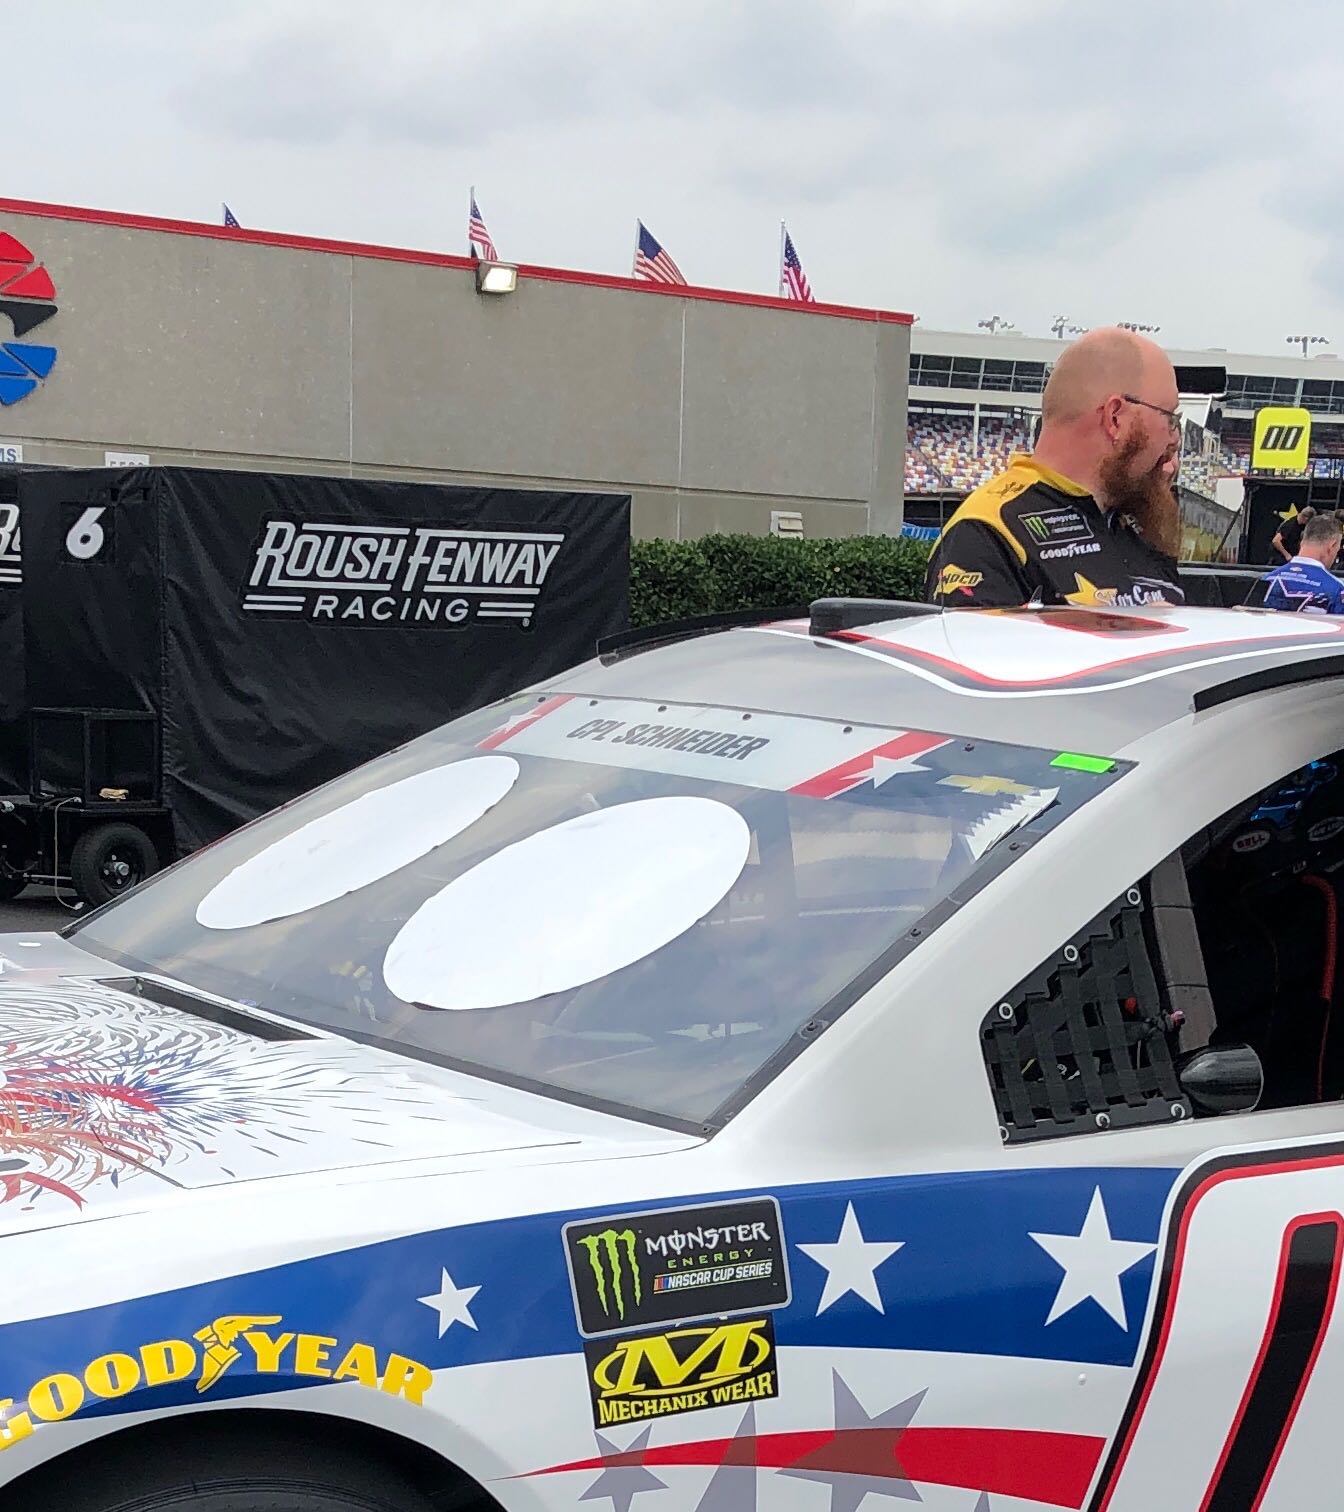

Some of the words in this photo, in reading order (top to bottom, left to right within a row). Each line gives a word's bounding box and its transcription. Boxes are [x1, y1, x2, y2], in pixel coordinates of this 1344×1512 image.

[1260, 425, 1304, 450] 00
[66, 507, 106, 560] 6
[249, 521, 408, 590] ROUSH
[402, 528, 564, 592] FENWAY
[1039, 543, 1102, 560] GOODYEAR
[312, 595, 470, 622] RACING
[566, 718, 626, 741] CPL
[612, 723, 770, 761] SCHNEIDER
[645, 1221, 771, 1257] MONSTER
[667, 1248, 754, 1270] ENERGY
[667, 1271, 712, 1289] NASCAR
[712, 1267, 735, 1283] CUP
[735, 1261, 773, 1279] SERIES
[596, 1391, 709, 1425] MECHANIX
[712, 1371, 775, 1403] WEAR
